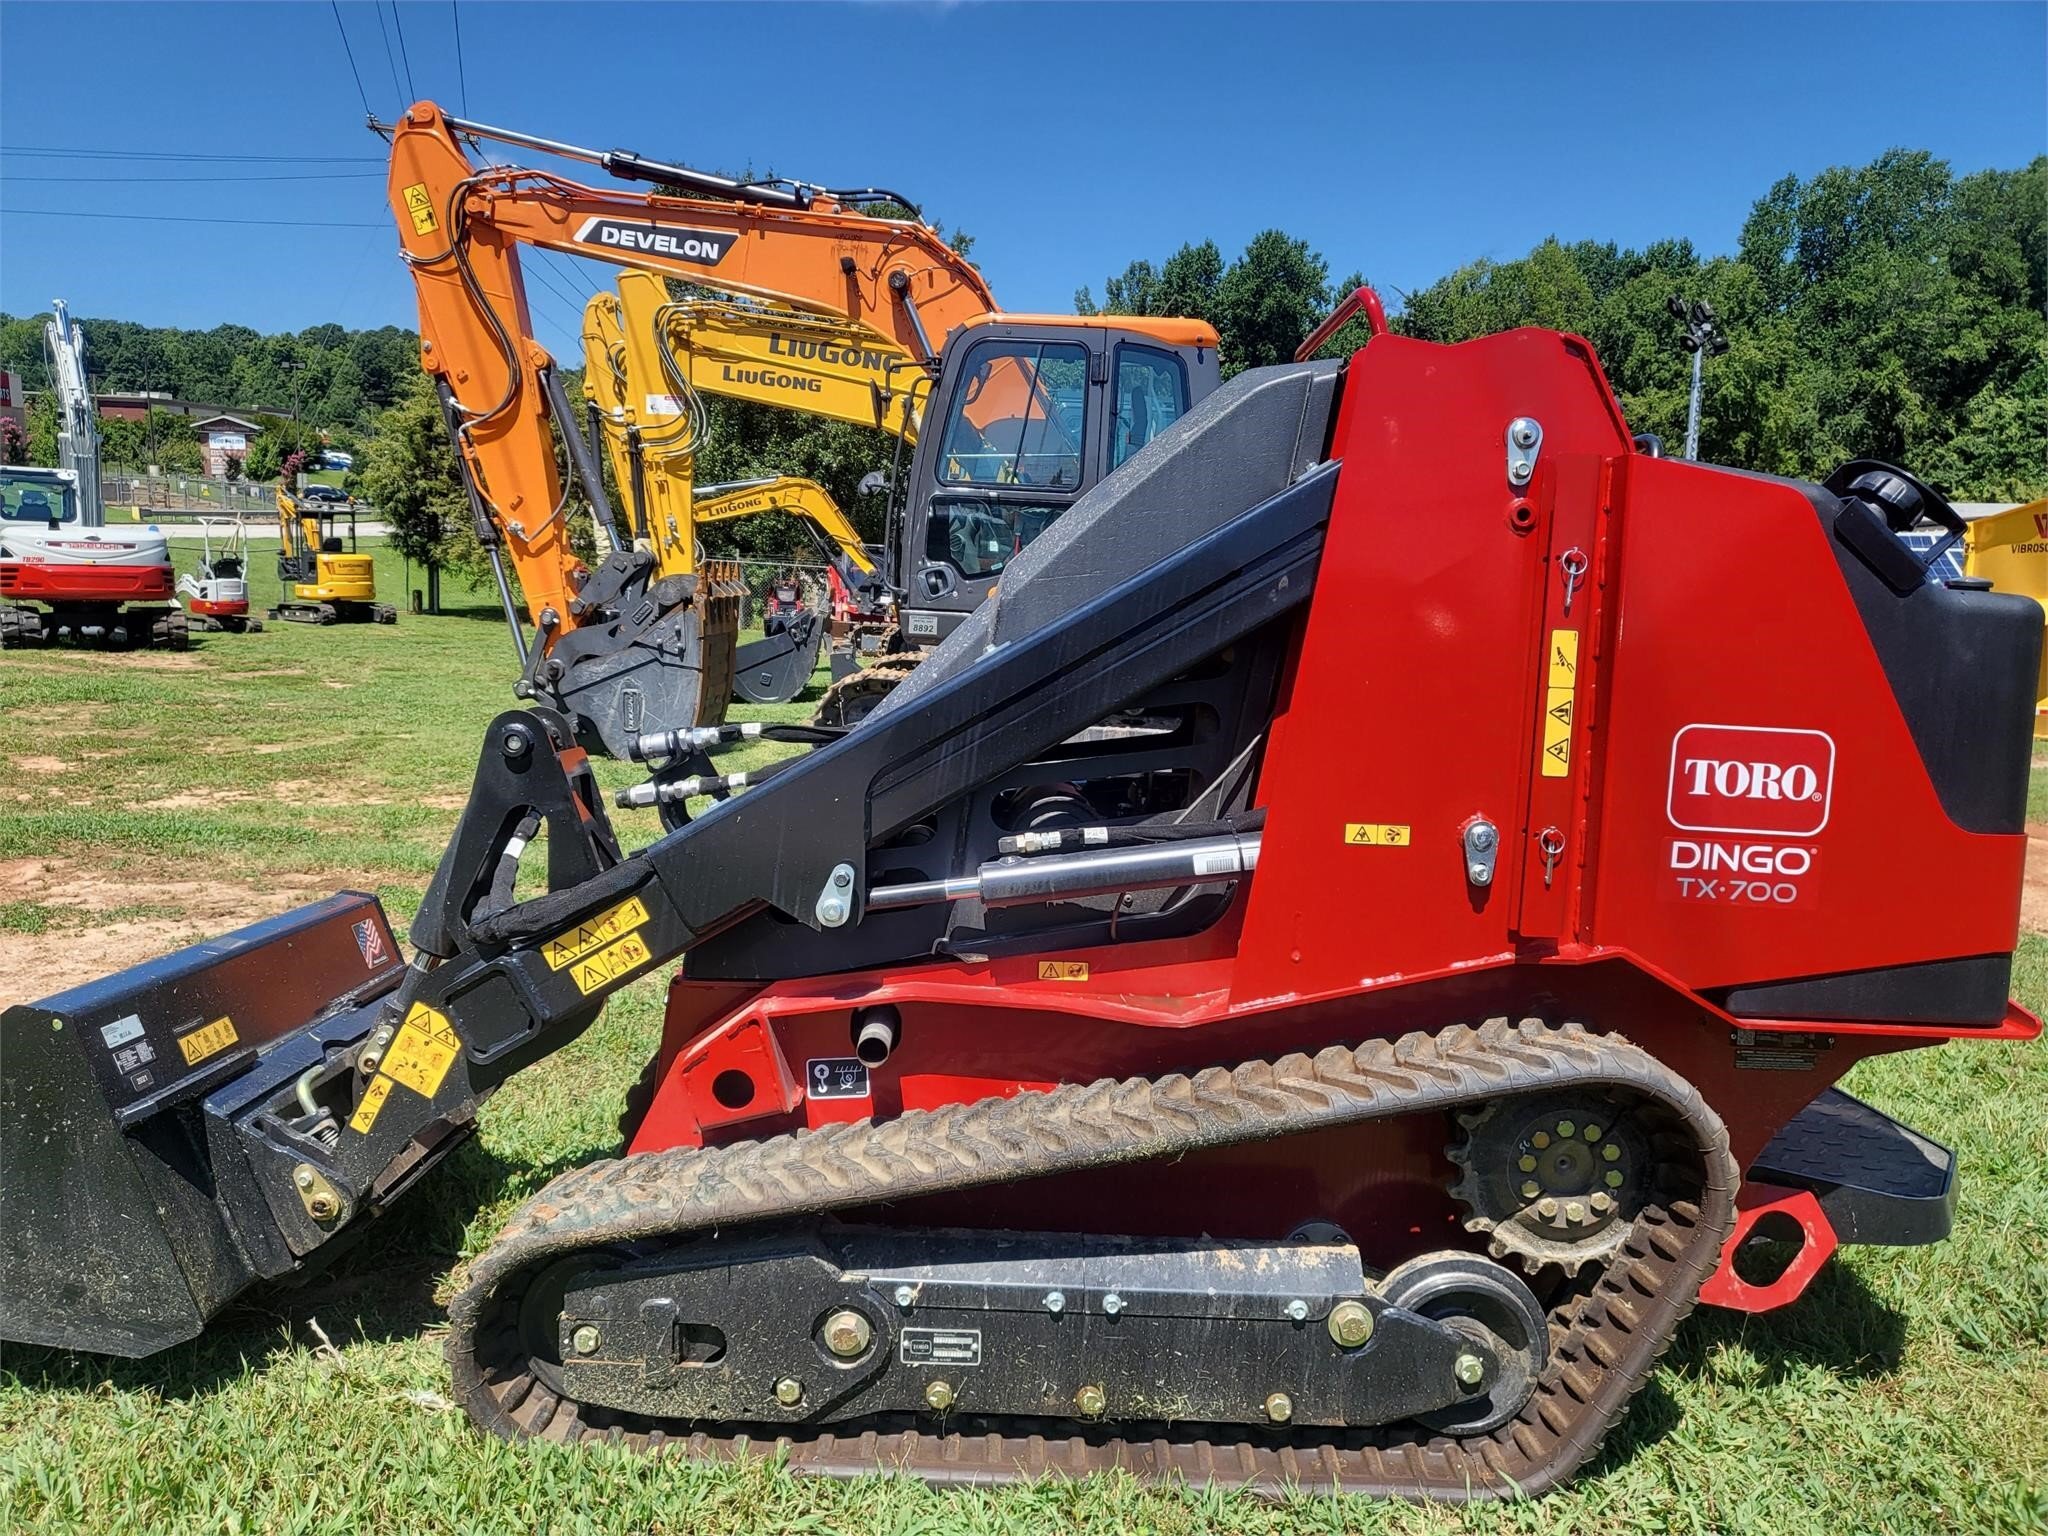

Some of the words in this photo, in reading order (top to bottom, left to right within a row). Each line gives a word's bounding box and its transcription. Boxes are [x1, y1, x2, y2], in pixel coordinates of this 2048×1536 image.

[600, 226, 720, 260] DEVELON
[912, 624, 934, 633] 8892
[1670, 841, 1811, 875] DINGO
